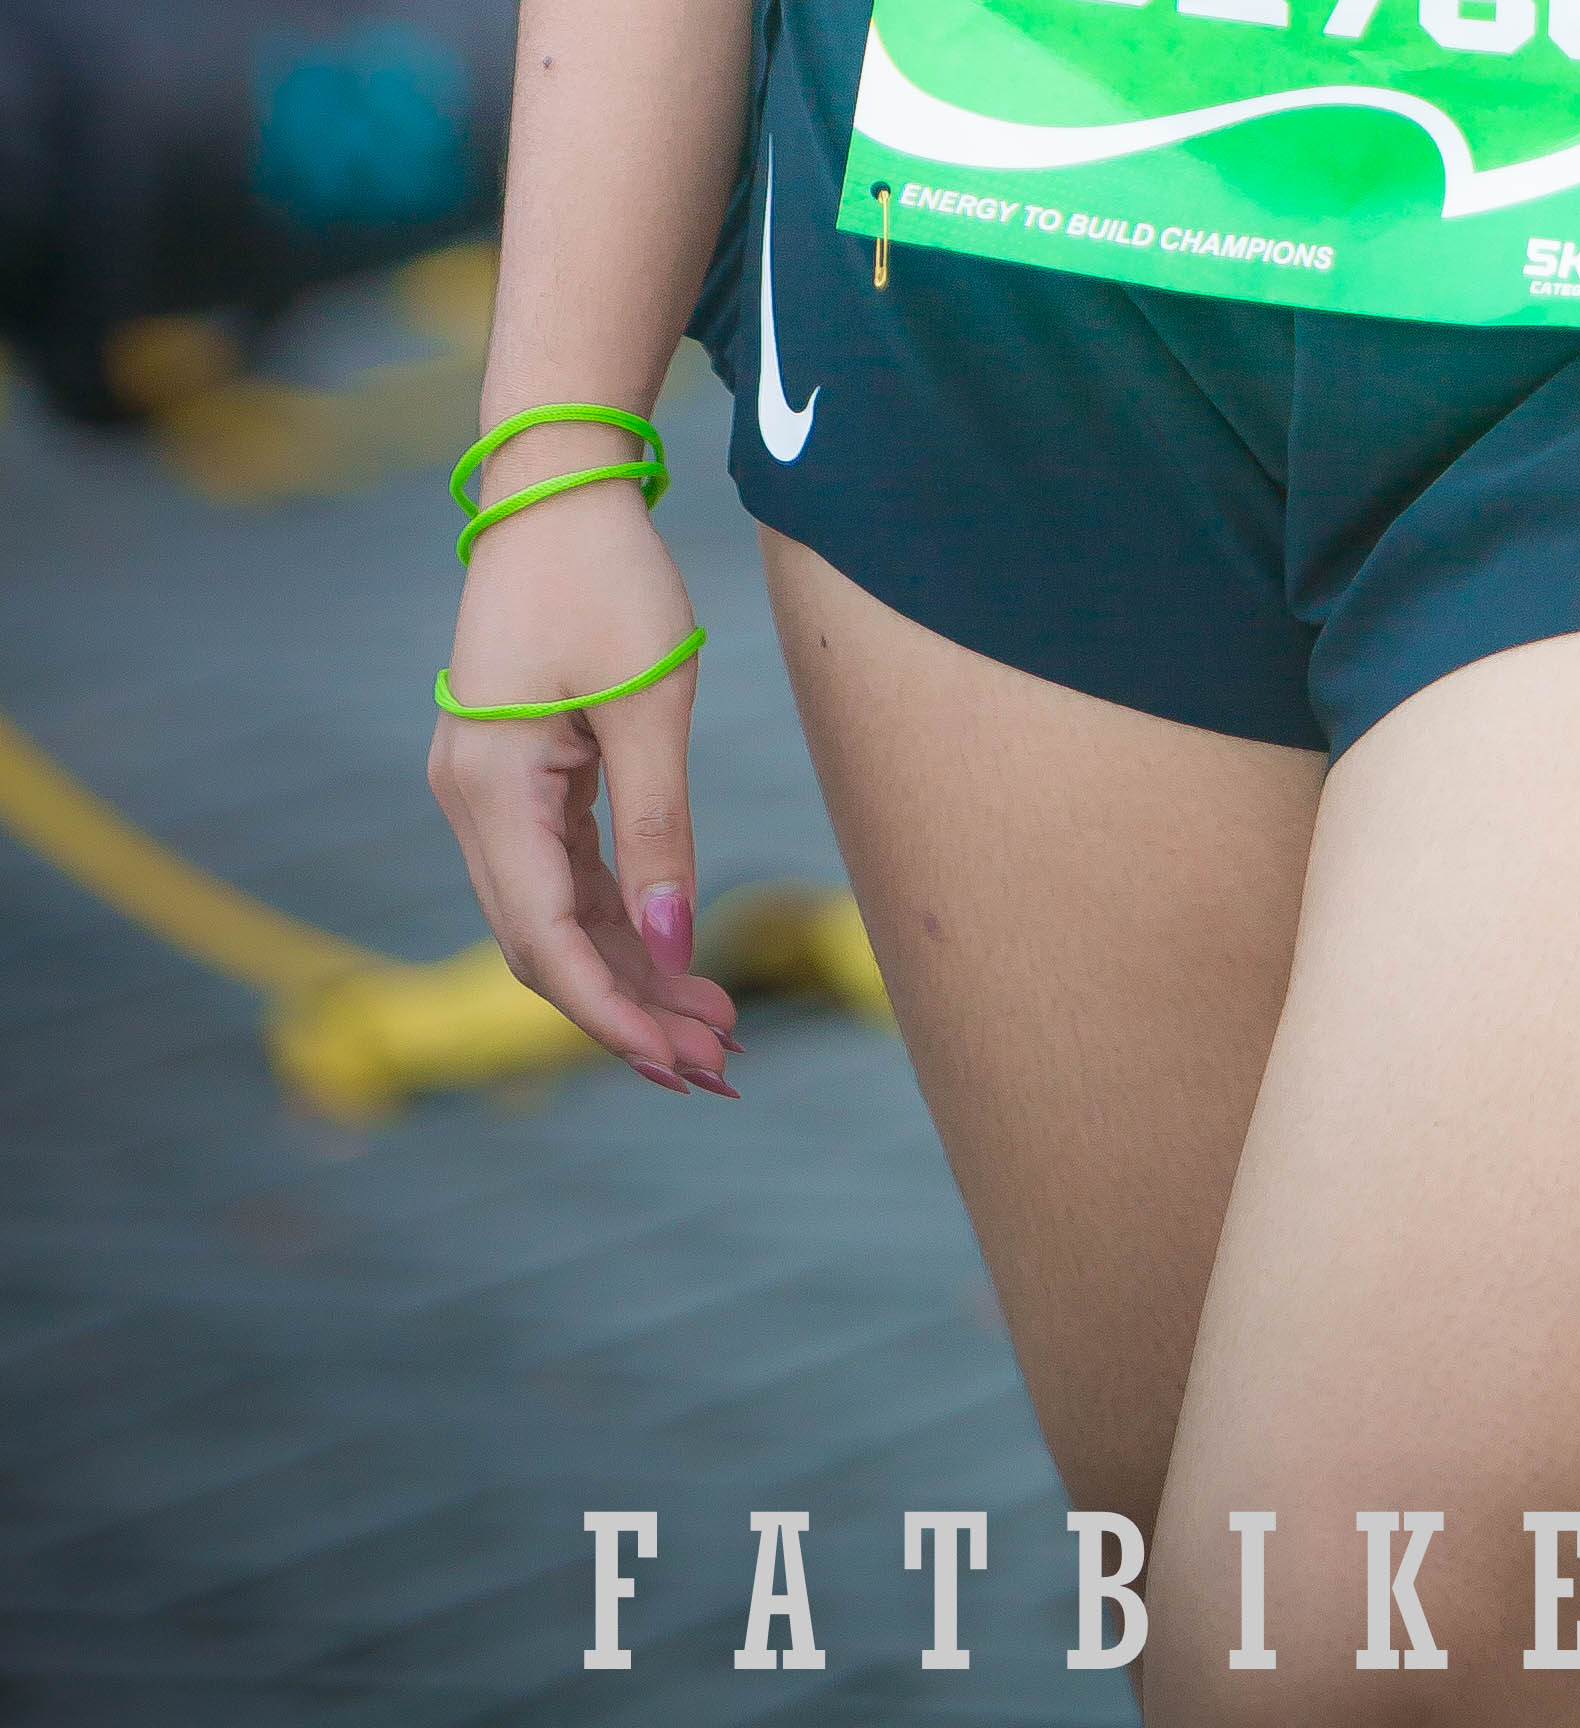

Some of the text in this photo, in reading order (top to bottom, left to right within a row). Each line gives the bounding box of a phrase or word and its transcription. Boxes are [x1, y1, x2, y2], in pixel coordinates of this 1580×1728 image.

[899, 182, 1335, 271] ENERGY TO BUILD CHAMPIONS
